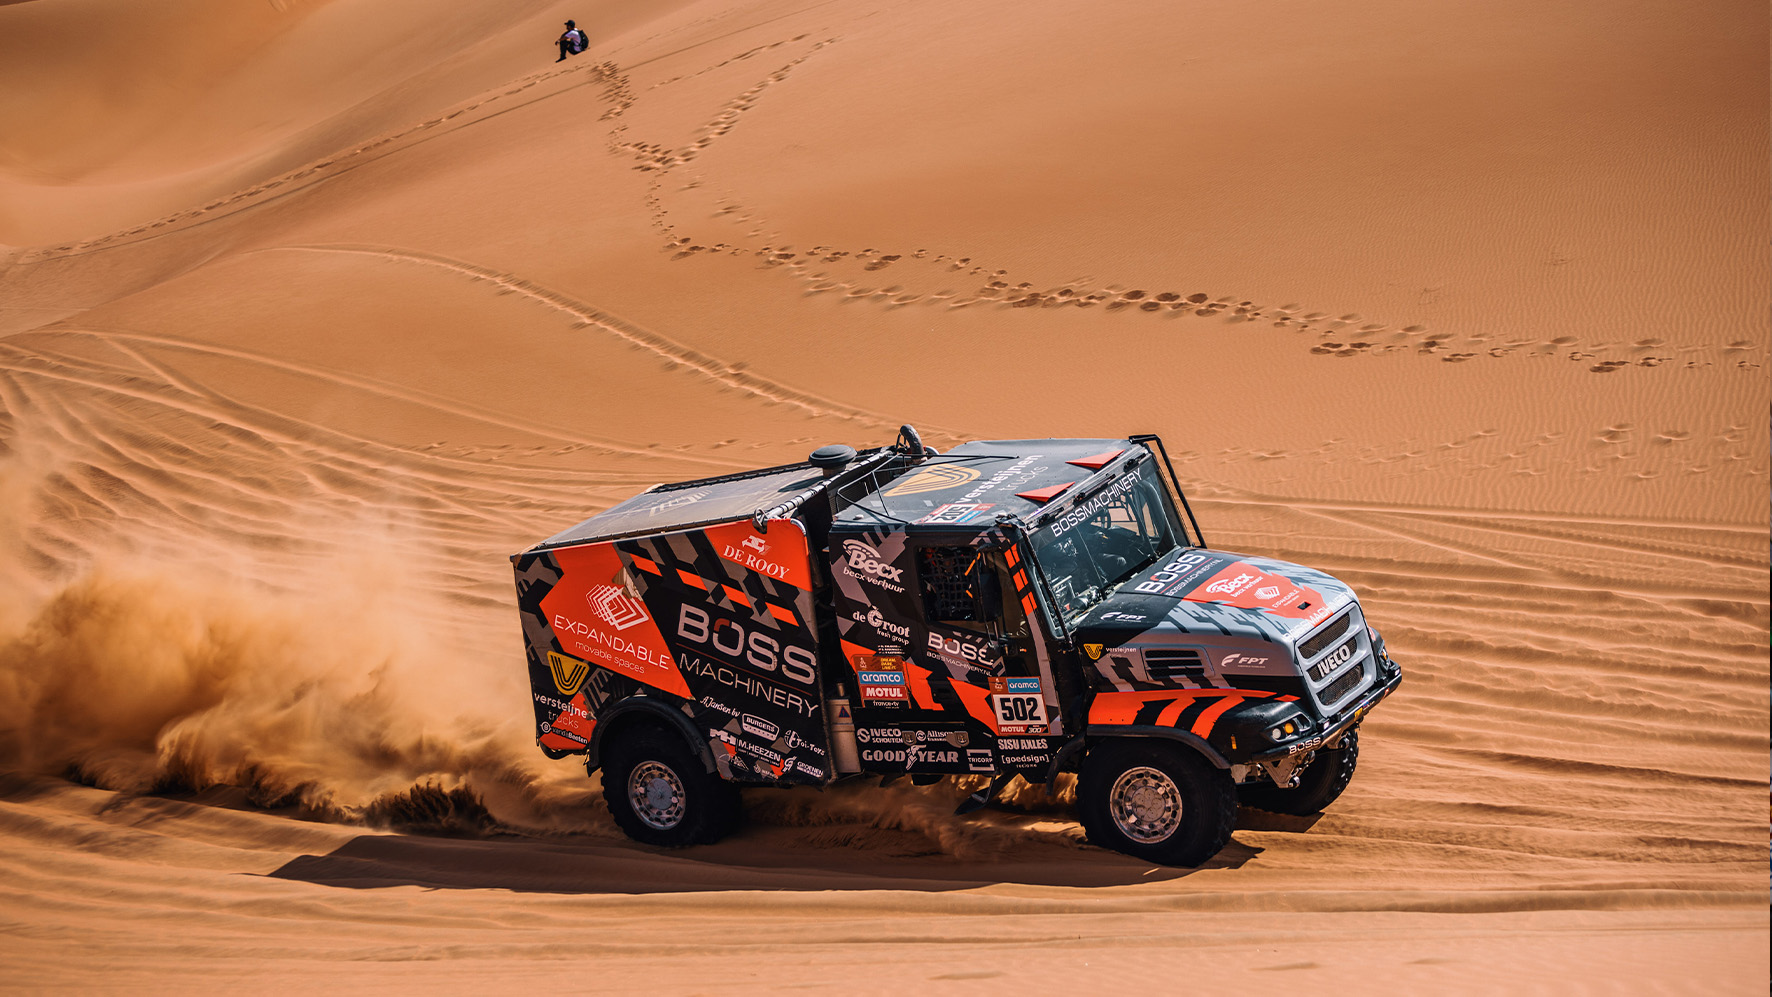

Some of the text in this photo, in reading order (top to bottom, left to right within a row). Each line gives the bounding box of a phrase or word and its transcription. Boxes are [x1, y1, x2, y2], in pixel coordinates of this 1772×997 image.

[955, 454, 1044, 504] versteijnen
[998, 465, 1049, 491] trucks
[1051, 468, 1142, 538] BOSSMACHINERY
[723, 545, 790, 579] DE ROOY
[848, 549, 904, 583] Becx
[1135, 553, 1206, 593] BOSS
[843, 566, 905, 594] becx verhuur
[1217, 572, 1255, 594] Becx
[852, 605, 910, 638] de Groot
[554, 614, 671, 670] EXPANDABLE
[677, 602, 817, 685] BOSS
[892, 635, 910, 647] group
[575, 641, 645, 674] movable spaces
[1239, 657, 1269, 665] FPT
[1317, 644, 1351, 678] IVECO
[680, 653, 819, 718] MACHINERY
[861, 674, 901, 682] aramco
[534, 692, 588, 719] versteijne
[866, 687, 903, 698] MOTUL
[547, 710, 579, 729] trucks
[1000, 697, 1041, 721] 502
[746, 716, 775, 733] BURGERS
[870, 728, 902, 737] IVECO
[738, 739, 781, 762] M.HEEZEN
[862, 749, 959, 763] GOOD YEAR
[997, 738, 1049, 750] SISU AXLES
[1289, 736, 1321, 755] BOSS
